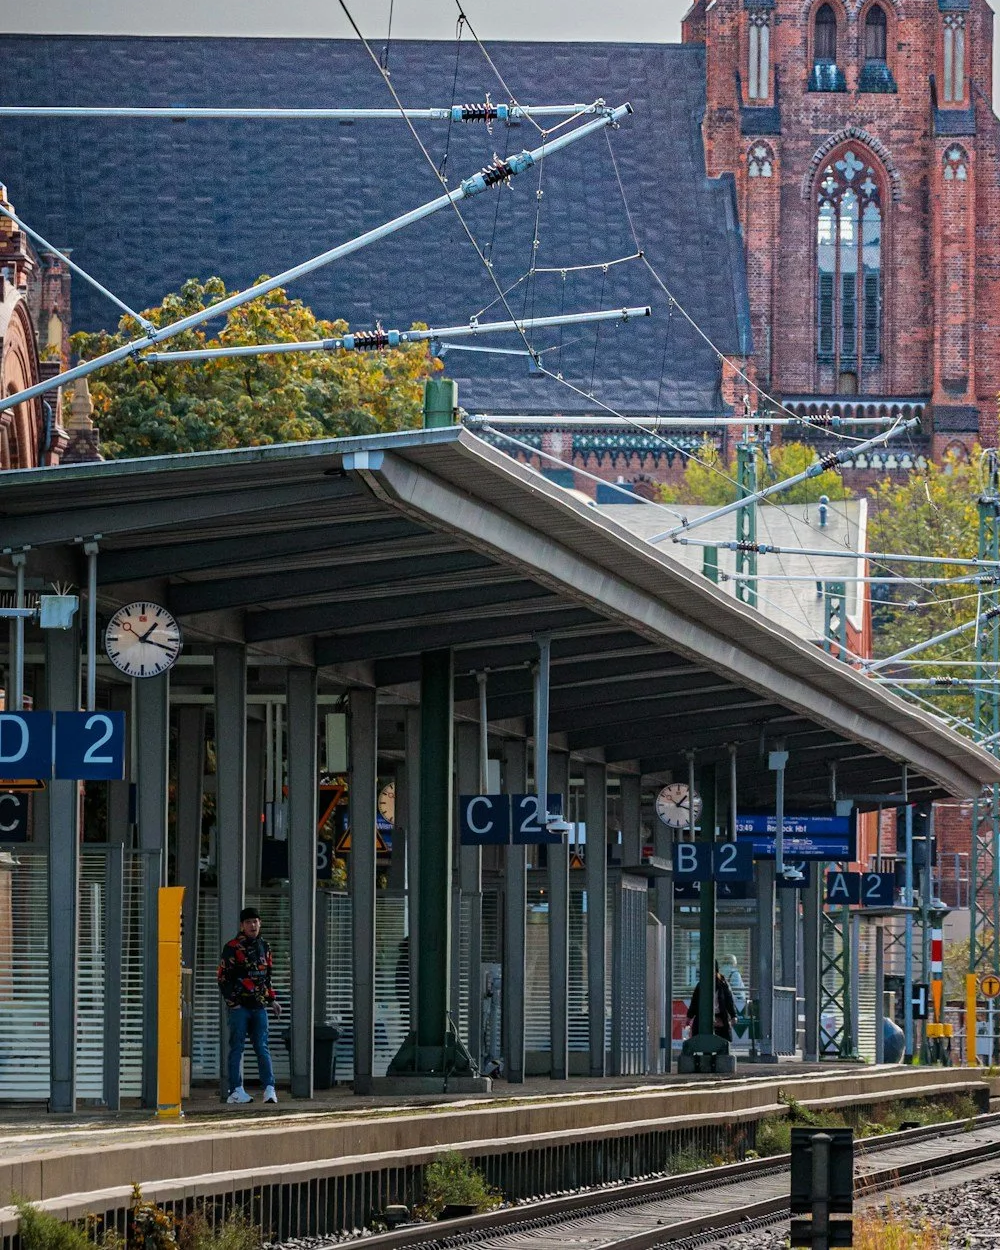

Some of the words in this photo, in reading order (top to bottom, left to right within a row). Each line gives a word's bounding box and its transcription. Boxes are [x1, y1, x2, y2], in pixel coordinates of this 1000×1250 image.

[0, 715, 29, 763] D
[83, 715, 114, 763] 2
[466, 796, 493, 834] C
[519, 796, 542, 833] 2
[766, 824, 793, 833] Roock
[677, 843, 698, 873] B
[719, 843, 738, 872] 2
[830, 873, 849, 898] A
[866, 873, 881, 898] 2
